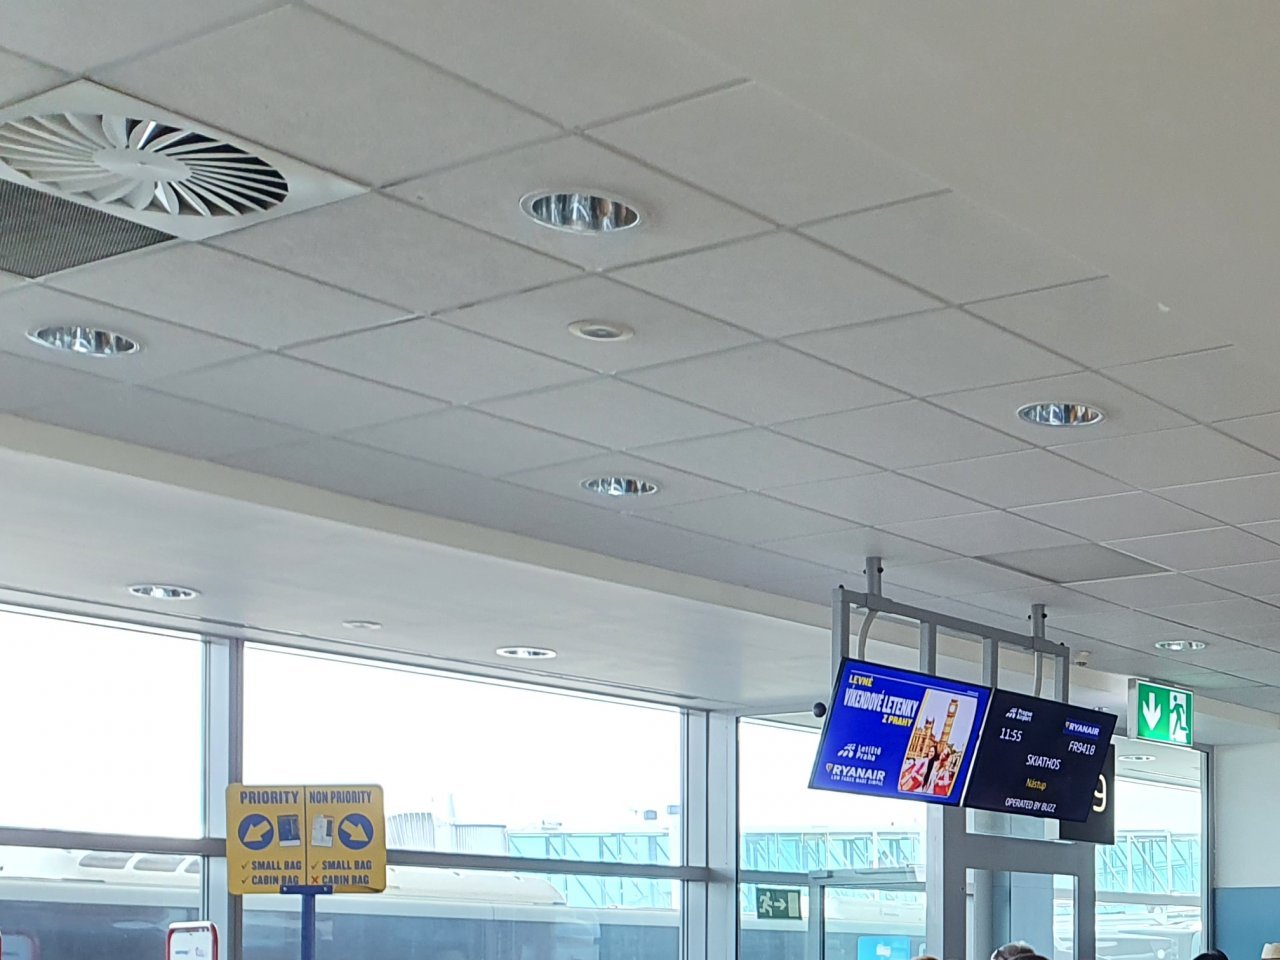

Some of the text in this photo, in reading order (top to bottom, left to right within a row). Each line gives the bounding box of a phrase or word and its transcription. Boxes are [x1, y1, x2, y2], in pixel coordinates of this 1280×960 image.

[849, 674, 874, 687] LEVNÉ
[844, 685, 919, 717] VÍKENDOVÉ LETENKY
[882, 714, 913, 727] Z PRAHY
[999, 727, 1023, 742] 11:55
[1068, 722, 1100, 736] RYANAIR
[1068, 741, 1096, 755] FR9418
[855, 751, 876, 762] Praha
[1025, 754, 1061, 770] SKIATHOS
[832, 764, 886, 781] RYANAIR
[240, 791, 299, 805] PRIORITY
[309, 790, 372, 804] NON PRIORITY
[1005, 797, 1057, 813] OPERATED BY BUZZ
[251, 860, 302, 871] SMALL BAG
[322, 860, 372, 870] SMALL BAG
[252, 874, 299, 885] CABIN BAG
[322, 874, 369, 885] CABIN BAG
